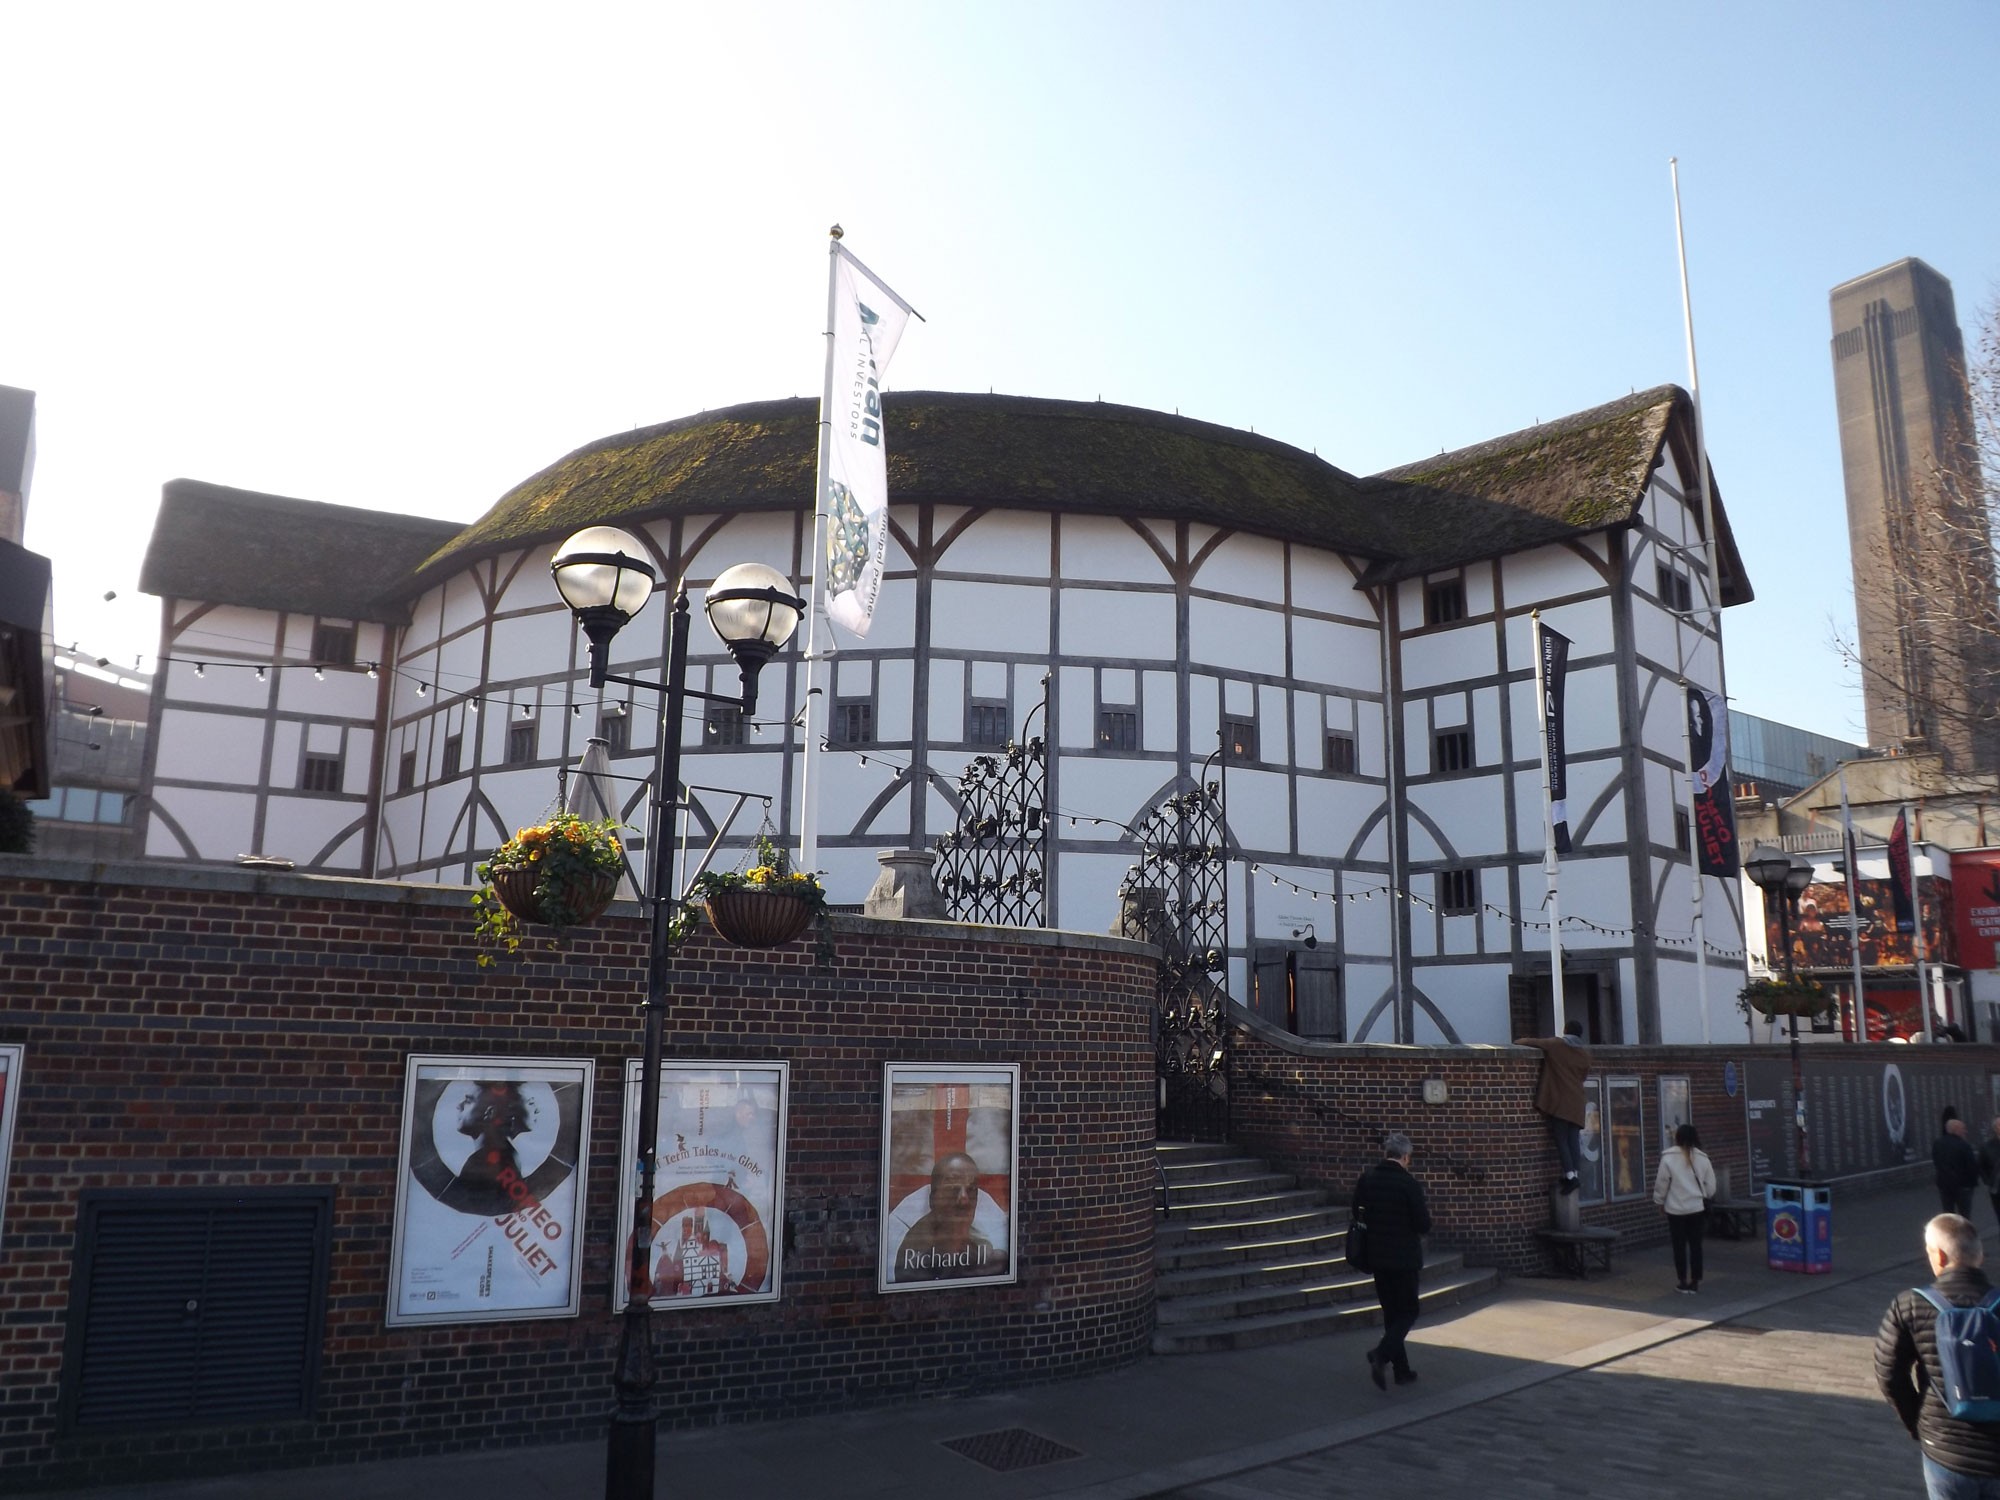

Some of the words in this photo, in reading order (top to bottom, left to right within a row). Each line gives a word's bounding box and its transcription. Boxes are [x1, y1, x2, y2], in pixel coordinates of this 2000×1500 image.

[851, 353, 866, 440] INVESTORS
[867, 567, 880, 619] partner
[1696, 801, 1725, 865] JULIET
[663, 1149, 690, 1165] Term
[692, 1145, 720, 1157] Tales
[738, 1154, 763, 1177] Globe
[496, 1166, 562, 1241] ROMEO
[495, 1214, 558, 1277] JULIET
[904, 1244, 970, 1270] Richard
[977, 1244, 987, 1265] II
[478, 1275, 486, 1298] GLOBE
